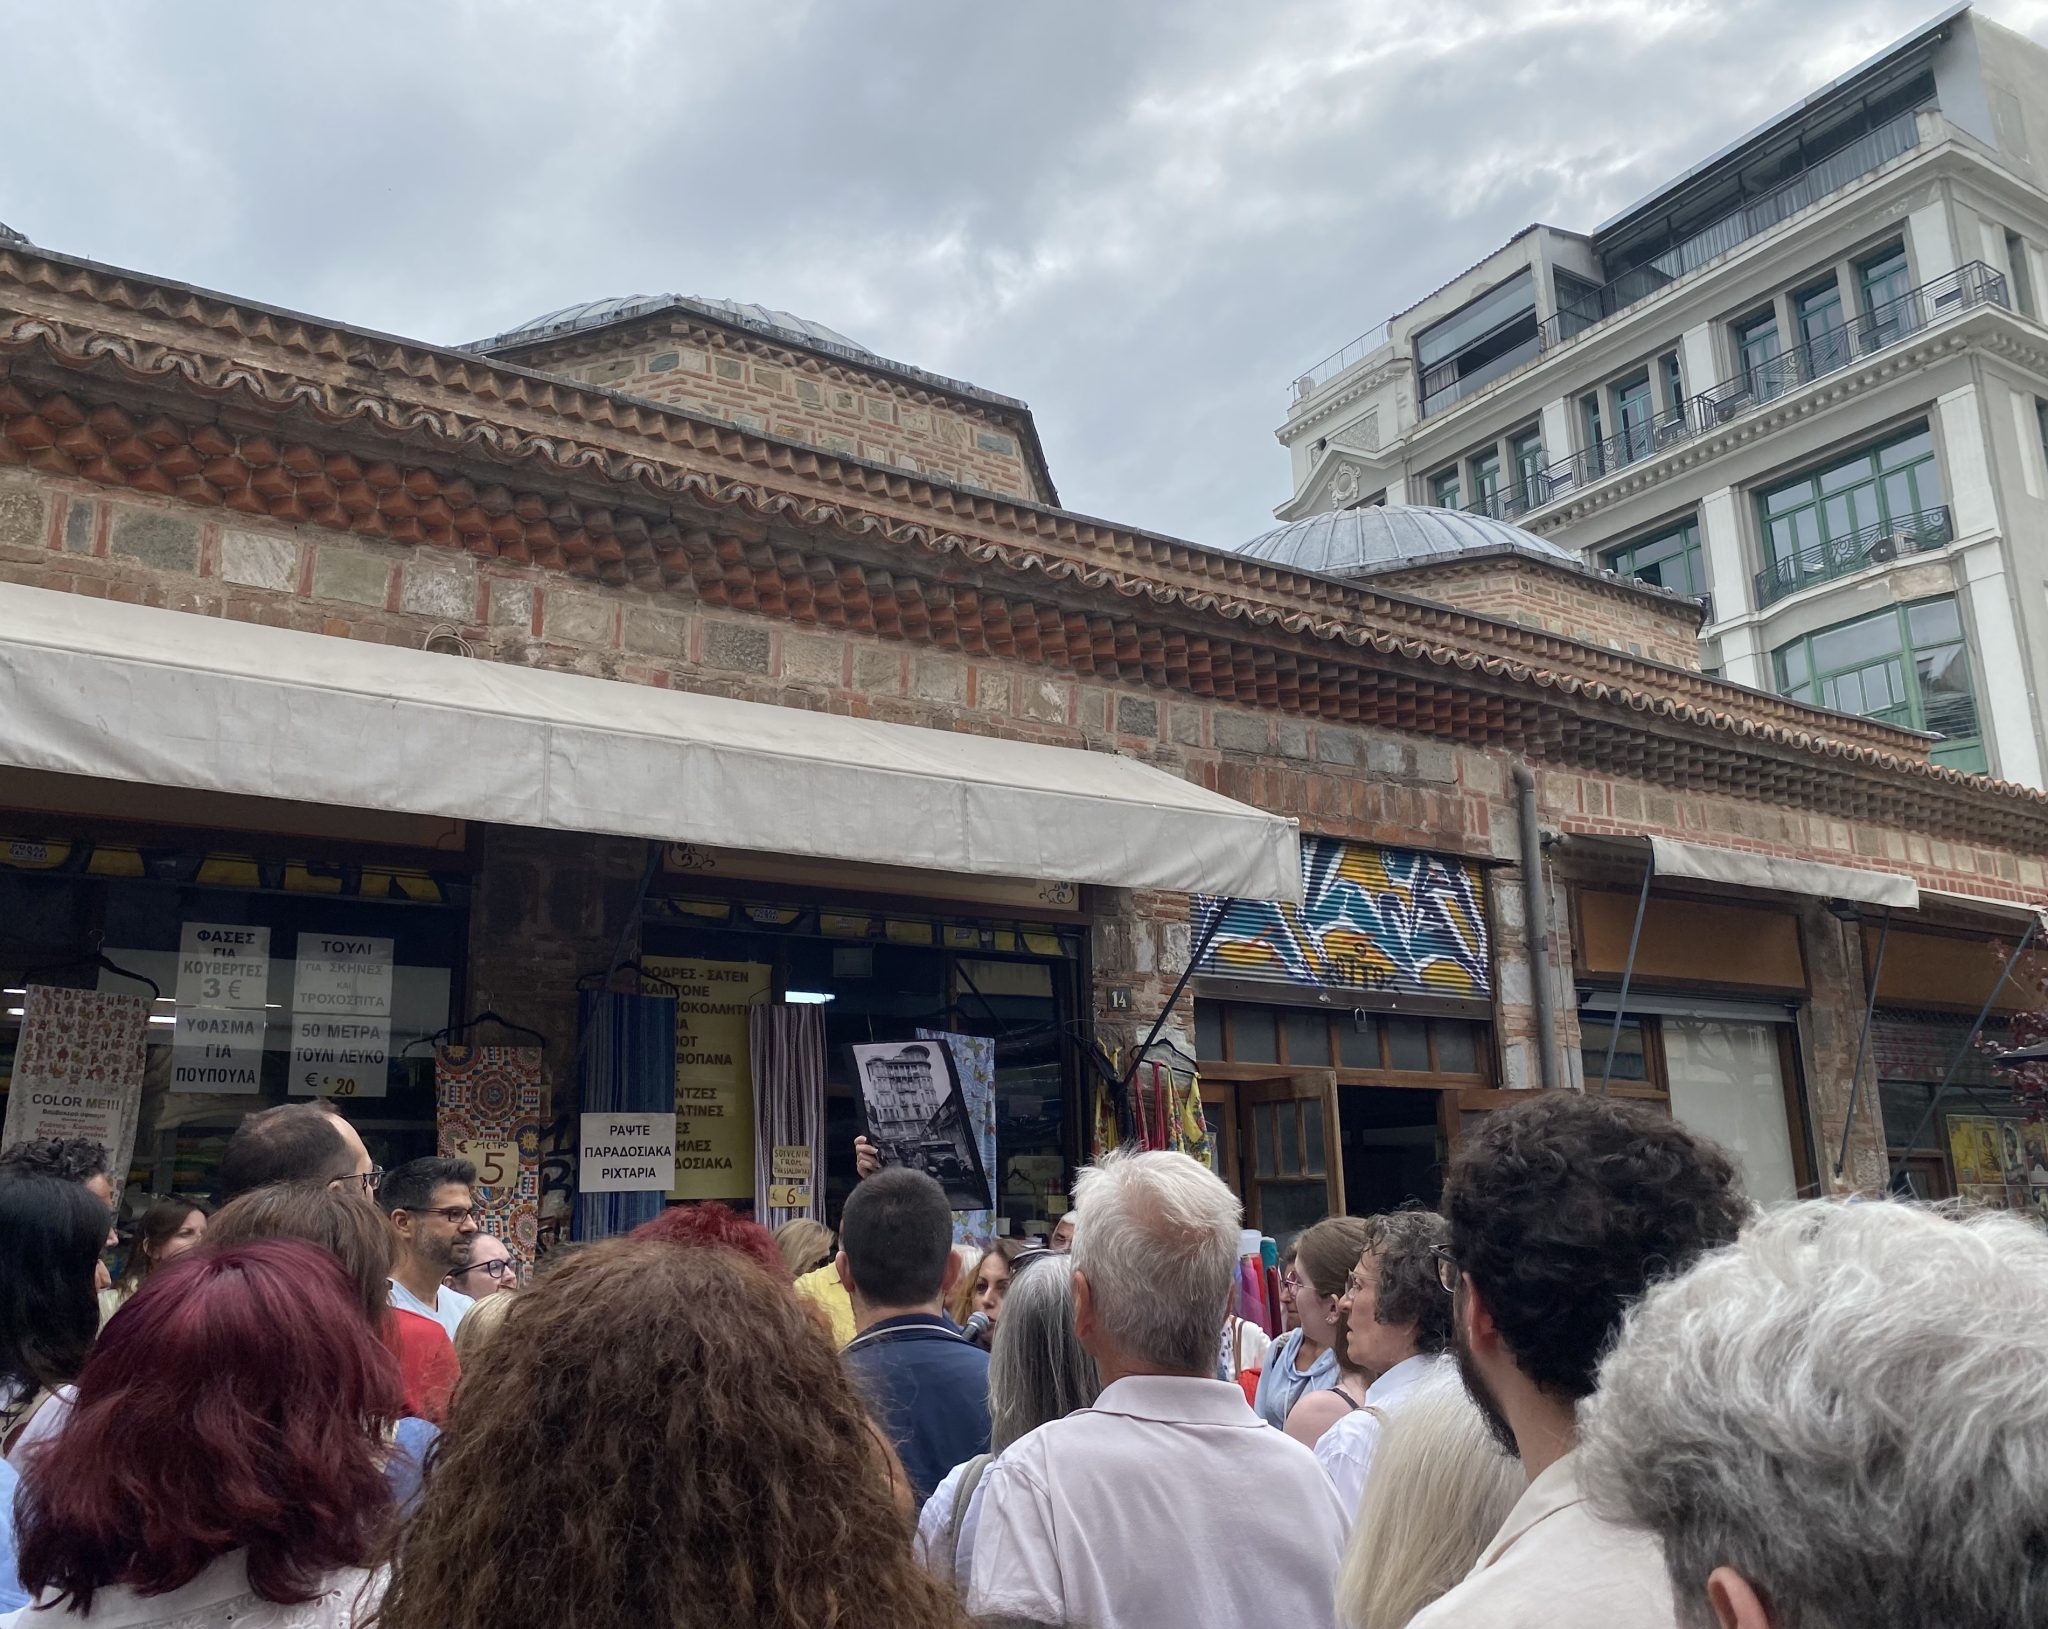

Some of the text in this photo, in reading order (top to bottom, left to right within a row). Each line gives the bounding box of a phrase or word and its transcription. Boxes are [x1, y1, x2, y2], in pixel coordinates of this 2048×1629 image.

[197, 930, 255, 944] ΦΑΣΕΣ
[213, 947, 236, 958] ΓΙΑ
[321, 941, 372, 955] ΤΟΥΛΙ
[183, 961, 263, 977] ΚΟΥΒΕΡΤΕΣ
[305, 962, 384, 975] ΓΙΑ ΣΚΗΝΕΣ
[706, 969, 749, 983] ΣΑΤΕΝ
[203, 978, 242, 999] 3 €
[336, 982, 351, 990] ΚΑΙ
[300, 993, 384, 1006] ΤΡΟΧΟΣΠΙΤΑ
[1111, 991, 1126, 1008] 14
[186, 1019, 254, 1035] ΥΦΑΣΜΑ
[301, 1023, 380, 1039] 50 ΜΕΤΡΑ
[205, 1043, 232, 1058] ΓΙΑ
[295, 1047, 385, 1064] ΤΟΥΛΙ ΛΕΥΚΟ
[176, 1067, 256, 1083] ΠΟΥΠΟΥΛΑ
[304, 1072, 355, 1095] € 20
[32, 1093, 82, 1108] COLOR
[610, 1125, 650, 1136] ΡΑΨΤΕ
[456, 1140, 468, 1154] €
[584, 1146, 672, 1158] ΠΑΡΑΔΟΣΙΑΚΑ
[479, 1152, 506, 1185] 5
[602, 1167, 657, 1179] ΡΙΧΤΑΡΙΑ
[786, 1187, 796, 1205] 6
